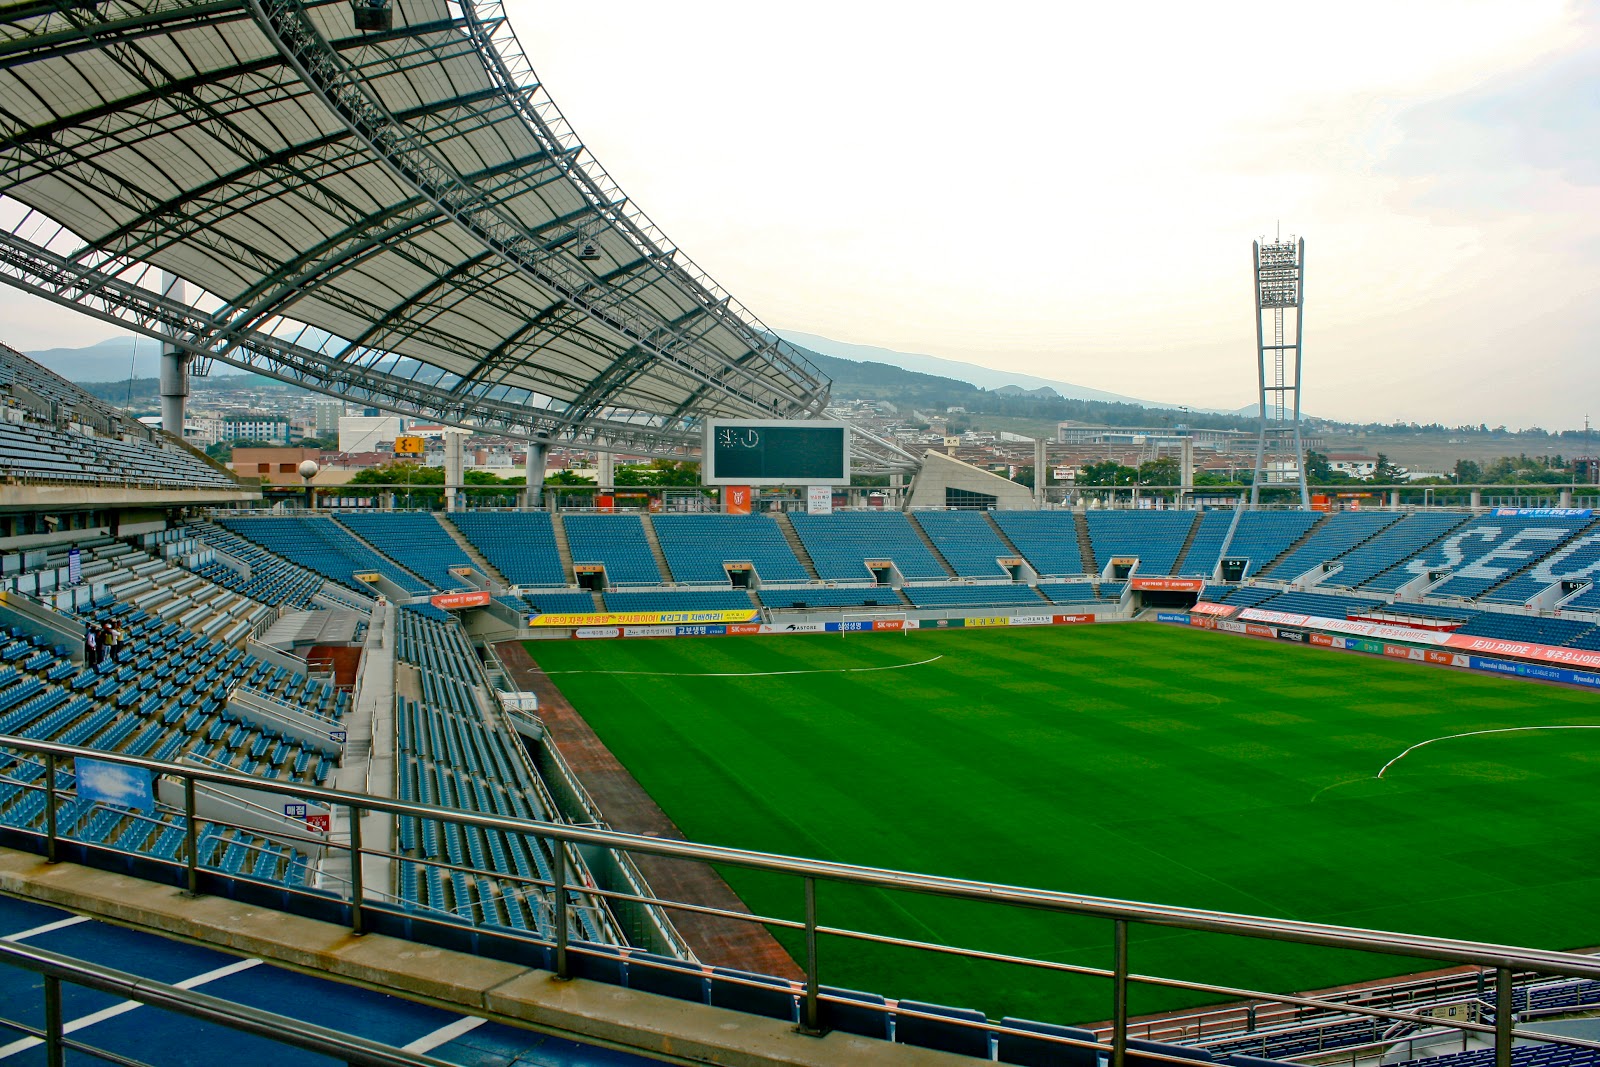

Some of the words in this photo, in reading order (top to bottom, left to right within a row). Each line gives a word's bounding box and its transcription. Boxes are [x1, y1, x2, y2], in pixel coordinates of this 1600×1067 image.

[543, 616, 567, 625] 제주의
[568, 616, 584, 624] 자랑
[660, 613, 688, 622] K리그를
[690, 612, 723, 621] 지배하라!
[968, 618, 1006, 626] 서귀포시
[838, 622, 861, 630] 삼성생명
[1323, 620, 1341, 629] JEJU
[1341, 622, 1368, 633] PRIDE
[677, 627, 706, 635] 교보생명
[1312, 635, 1319, 643] SK
[1387, 646, 1395, 654] SK
[1470, 639, 1496, 649] JEJU
[1496, 643, 1530, 655] PRIDE
[1430, 652, 1438, 660] SK
[1479, 661, 1498, 670] Hyundai
[1573, 674, 1594, 684] Hyundai
[286, 805, 305, 815] 매점
